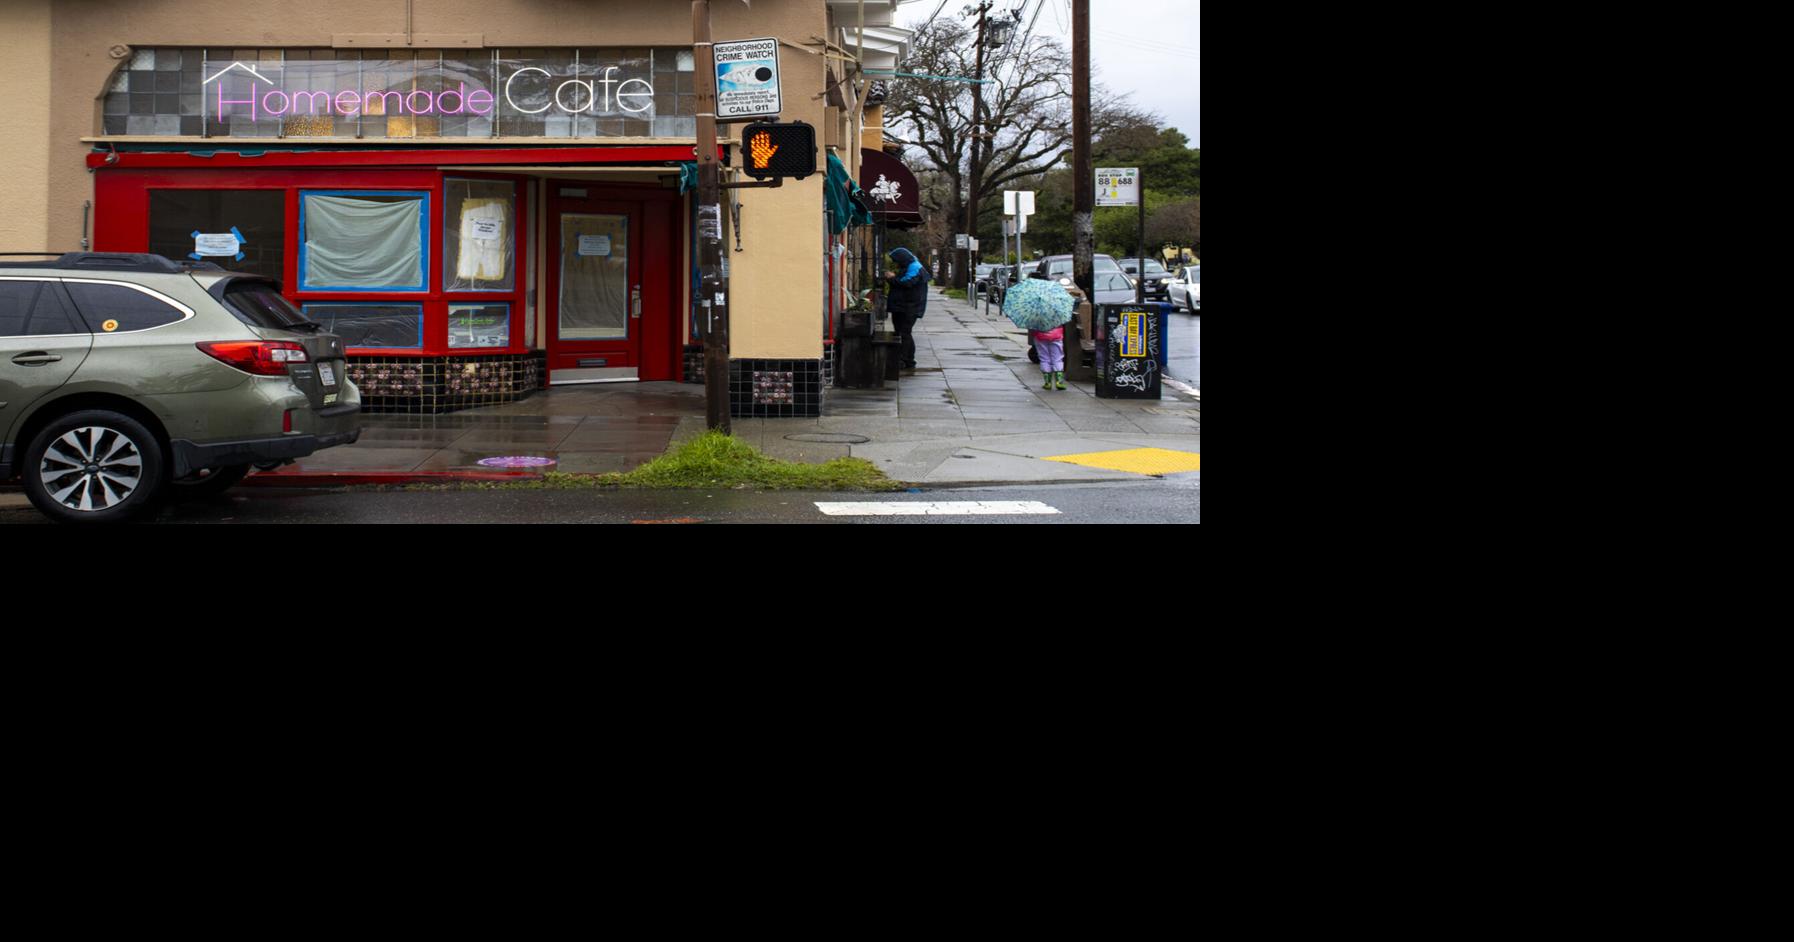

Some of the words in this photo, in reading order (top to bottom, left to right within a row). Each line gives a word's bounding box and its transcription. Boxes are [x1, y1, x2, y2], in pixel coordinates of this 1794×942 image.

[716, 43, 773, 53] NEIGHBORHOOD
[716, 52, 743, 61] CRIME
[746, 50, 774, 59] WATCH
[218, 81, 494, 122] Homemade
[505, 67, 655, 114] Cafe
